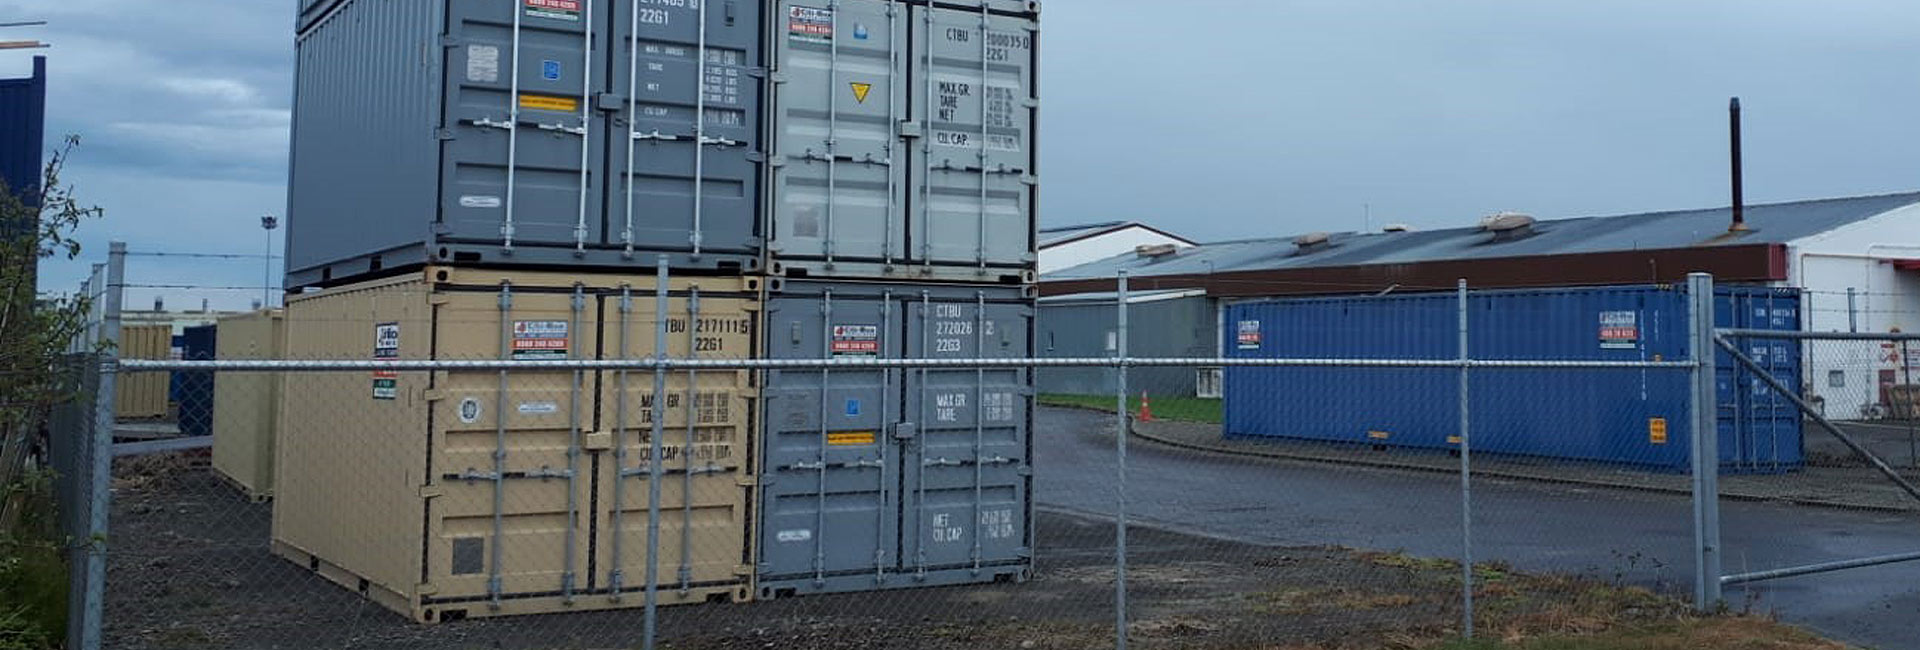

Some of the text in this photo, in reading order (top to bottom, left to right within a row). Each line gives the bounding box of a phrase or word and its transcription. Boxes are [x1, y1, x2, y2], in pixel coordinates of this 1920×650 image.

[946, 28, 969, 42] CTBU
[936, 304, 961, 318] CTBU
[663, 318, 686, 334] TBU
